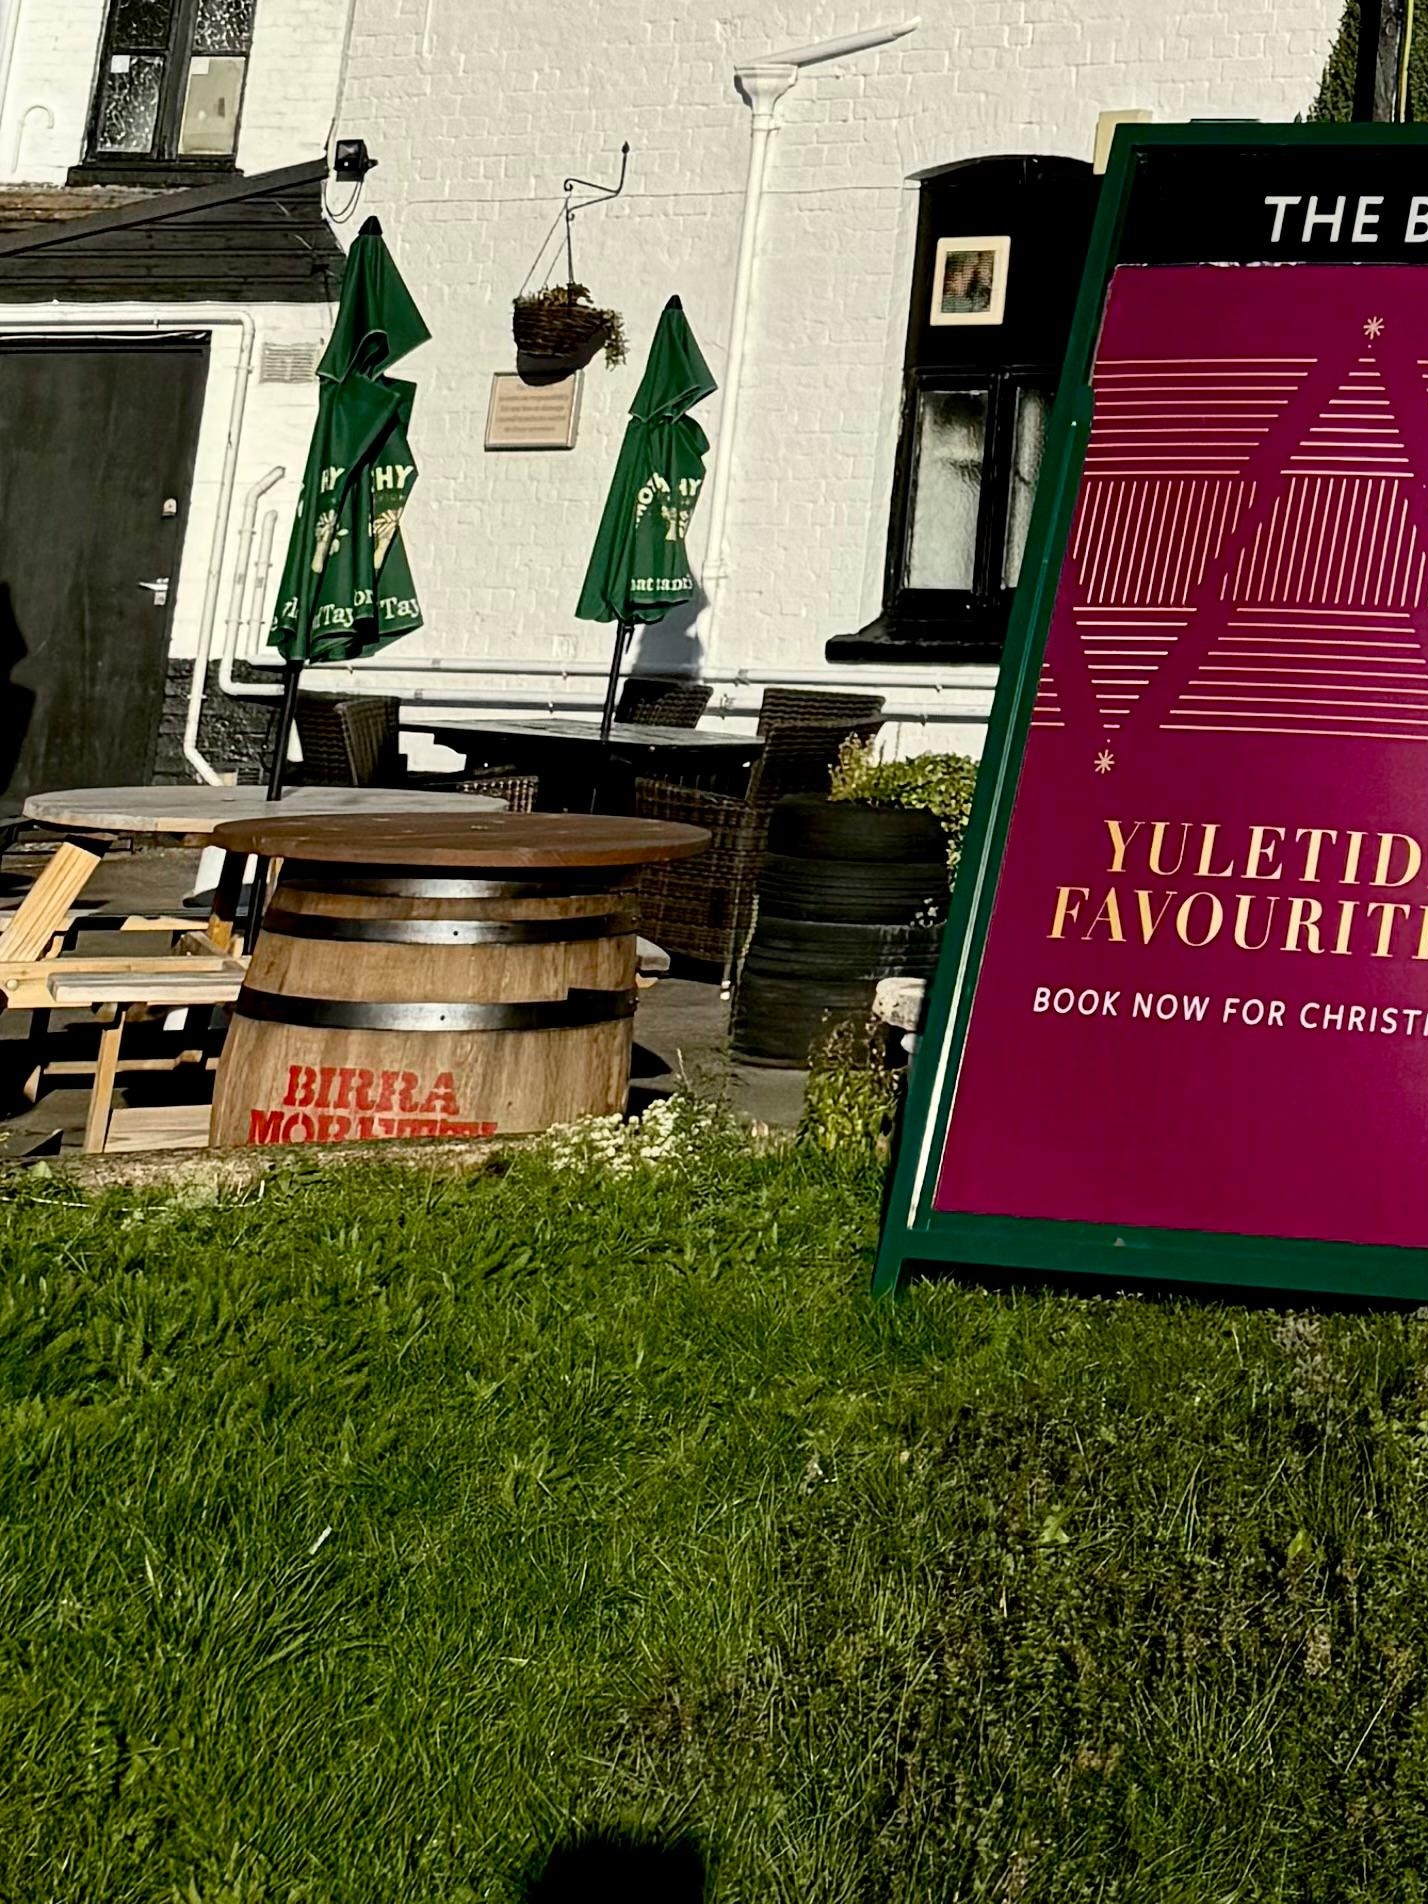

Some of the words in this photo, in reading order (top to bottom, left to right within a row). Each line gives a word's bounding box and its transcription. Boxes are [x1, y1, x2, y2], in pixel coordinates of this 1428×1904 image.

[1264, 195, 1385, 243] THE
[1033, 987, 1119, 1017] BOOK
[1132, 992, 1210, 1022] NOW
[1222, 997, 1288, 1028] FOR
[283, 1064, 460, 1116] BIRRA
